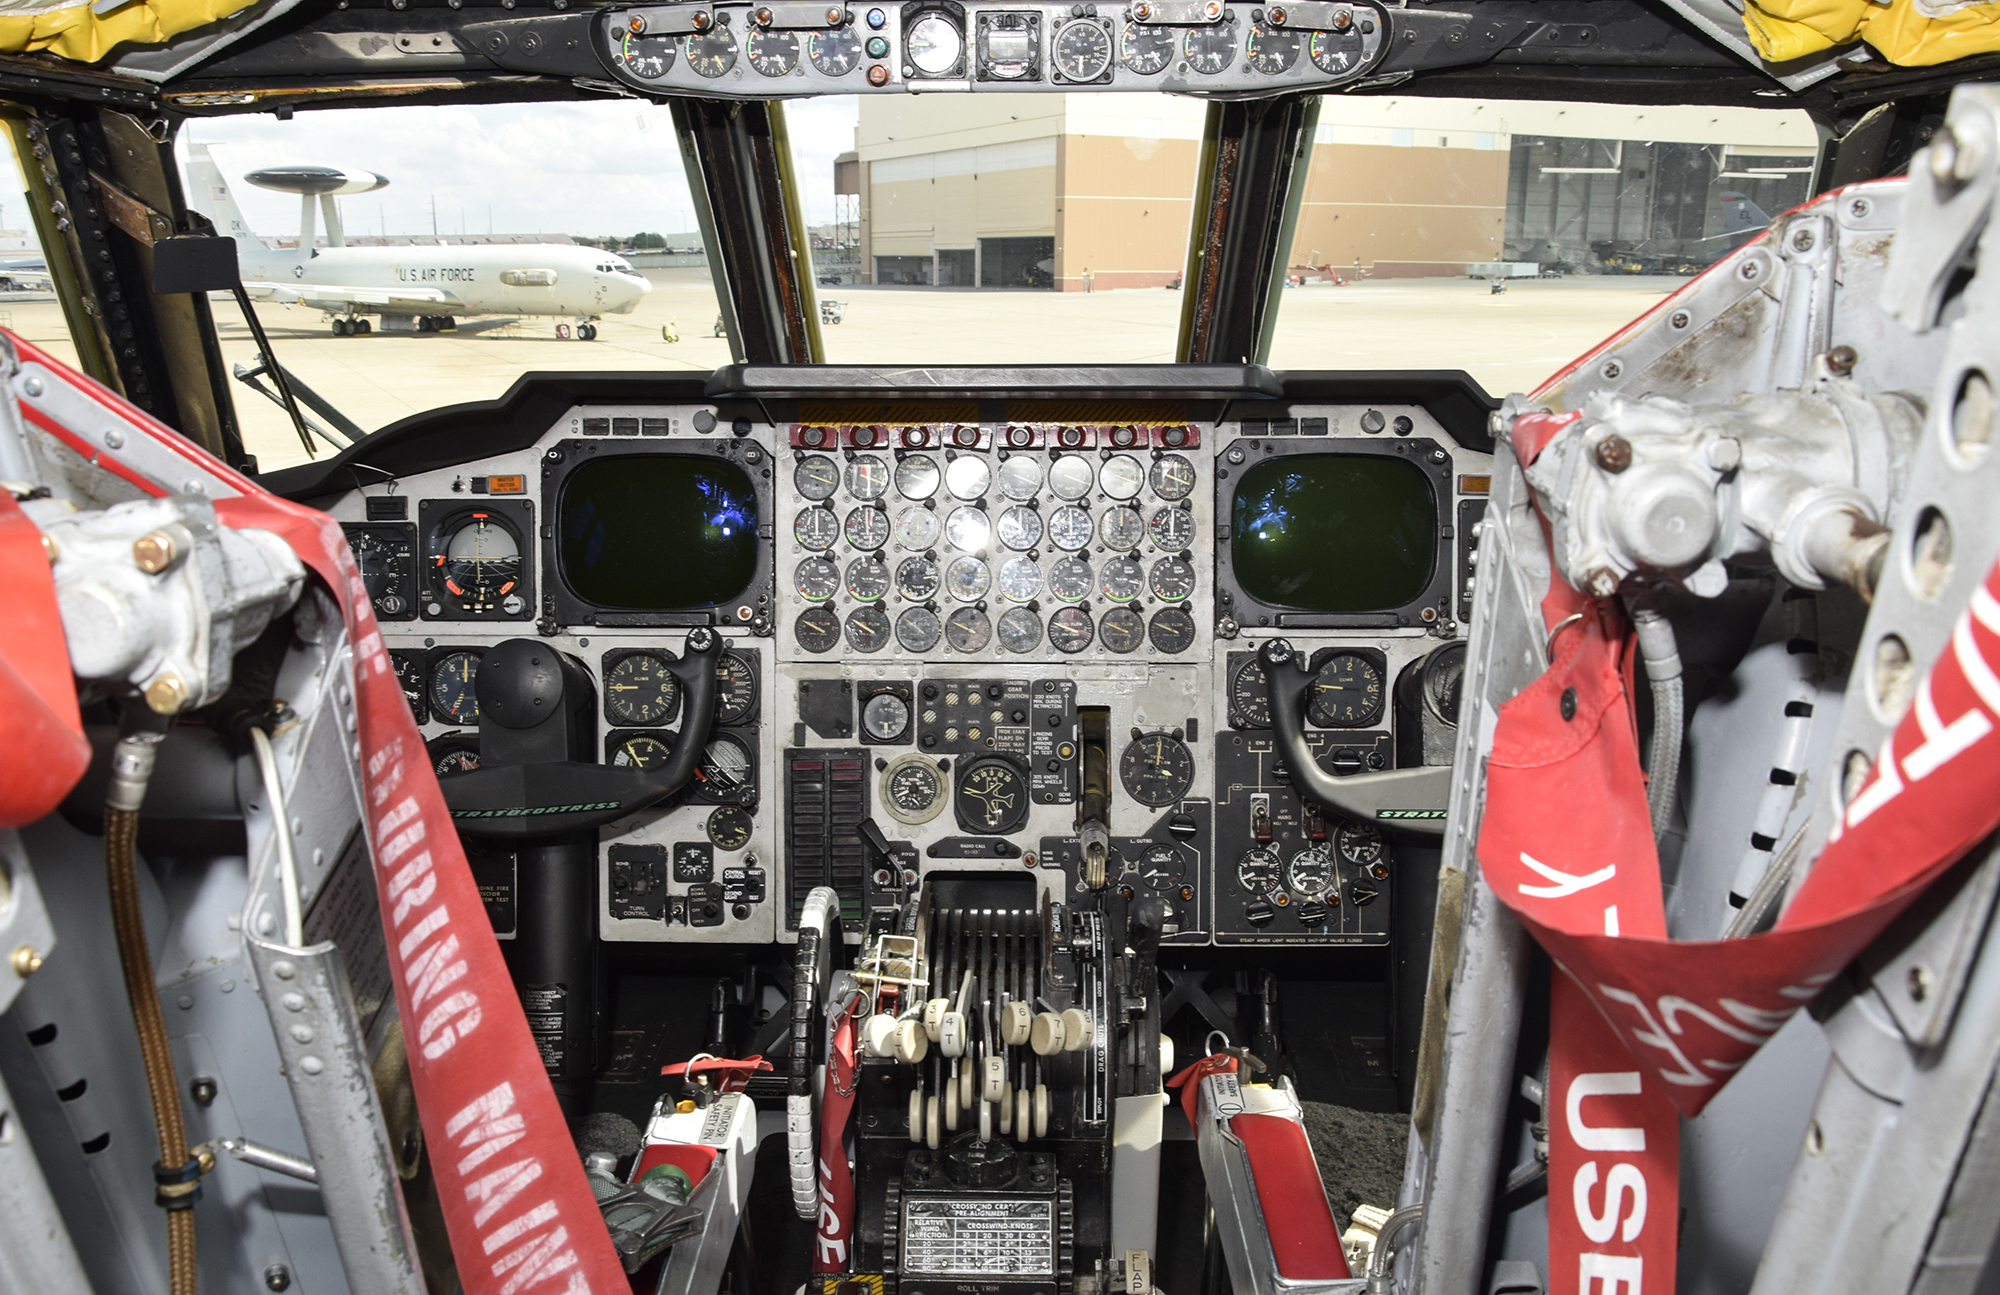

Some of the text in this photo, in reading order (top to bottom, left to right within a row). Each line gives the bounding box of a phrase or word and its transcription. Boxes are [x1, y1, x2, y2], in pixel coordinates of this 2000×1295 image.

[421, 268, 437, 282] AIR
[440, 268, 475, 281] FORCE
[690, 640, 710, 649] SELECT
[1269, 653, 1289, 663] SELECT
[928, 1004, 937, 1014] 3
[1018, 1007, 1027, 1017] 6
[945, 1017, 954, 1026] 4
[1053, 1019, 1061, 1029] 7
[895, 1027, 904, 1037] 2
[928, 1022, 937, 1032] T
[1019, 1025, 1028, 1035] T
[944, 1034, 954, 1045] T
[1055, 1036, 1063, 1047] T
[1097, 1023, 1105, 1073] DRAG CHUTE
[991, 1061, 1000, 1072] 5
[991, 1080, 1000, 1091] T
[702, 1103, 723, 1140] SAFETY PIN
[714, 1104, 734, 1138] INITIATOR
[968, 1151, 986, 1159] TURN
[1132, 1253, 1143, 1292] FLAP
